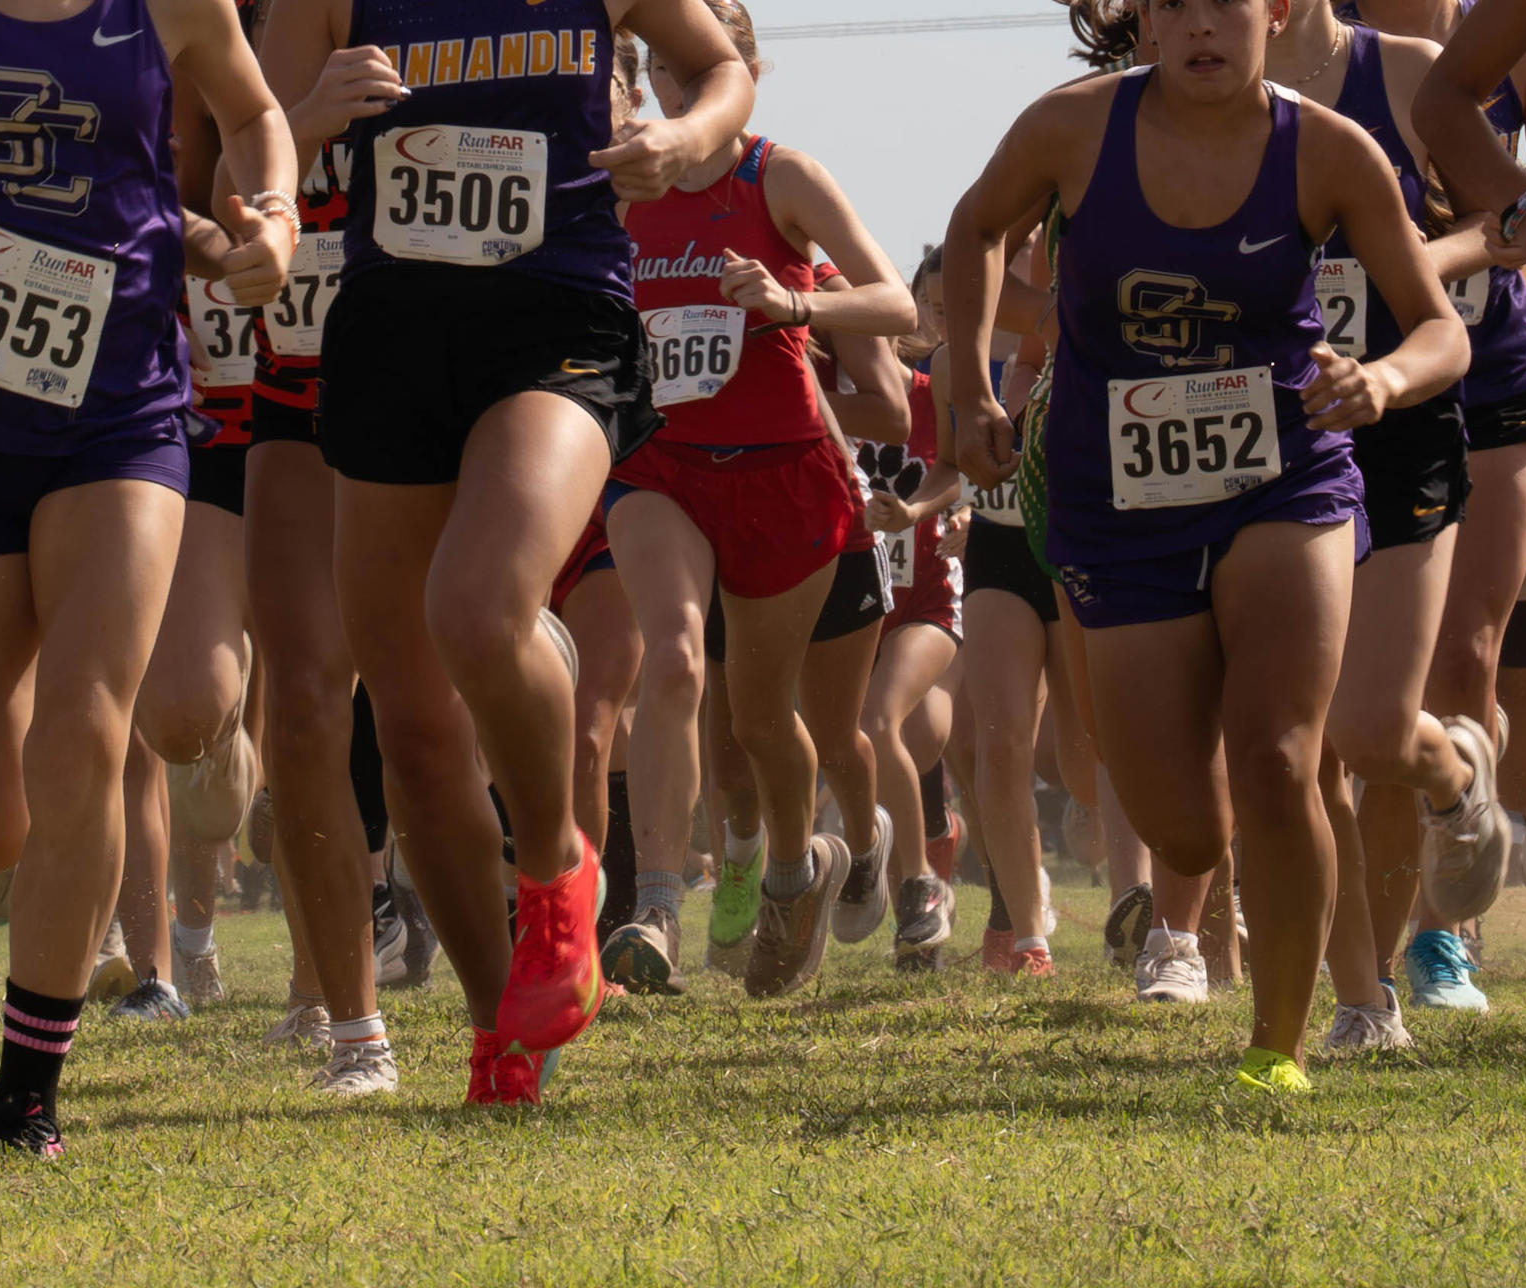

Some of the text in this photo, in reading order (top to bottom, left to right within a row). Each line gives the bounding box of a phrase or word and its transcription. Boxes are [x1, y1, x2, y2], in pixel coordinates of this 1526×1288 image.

[383, 29, 597, 89] ANHANDLE
[458, 132, 524, 150] RunFAR
[389, 165, 531, 236] 3506
[32, 249, 95, 279] RunFAR
[274, 272, 341, 327] 37
[682, 308, 728, 320] RunFAR
[203, 308, 256, 359] 37
[1185, 374, 1248, 394] RunFAR
[1121, 411, 1267, 478] 3652
